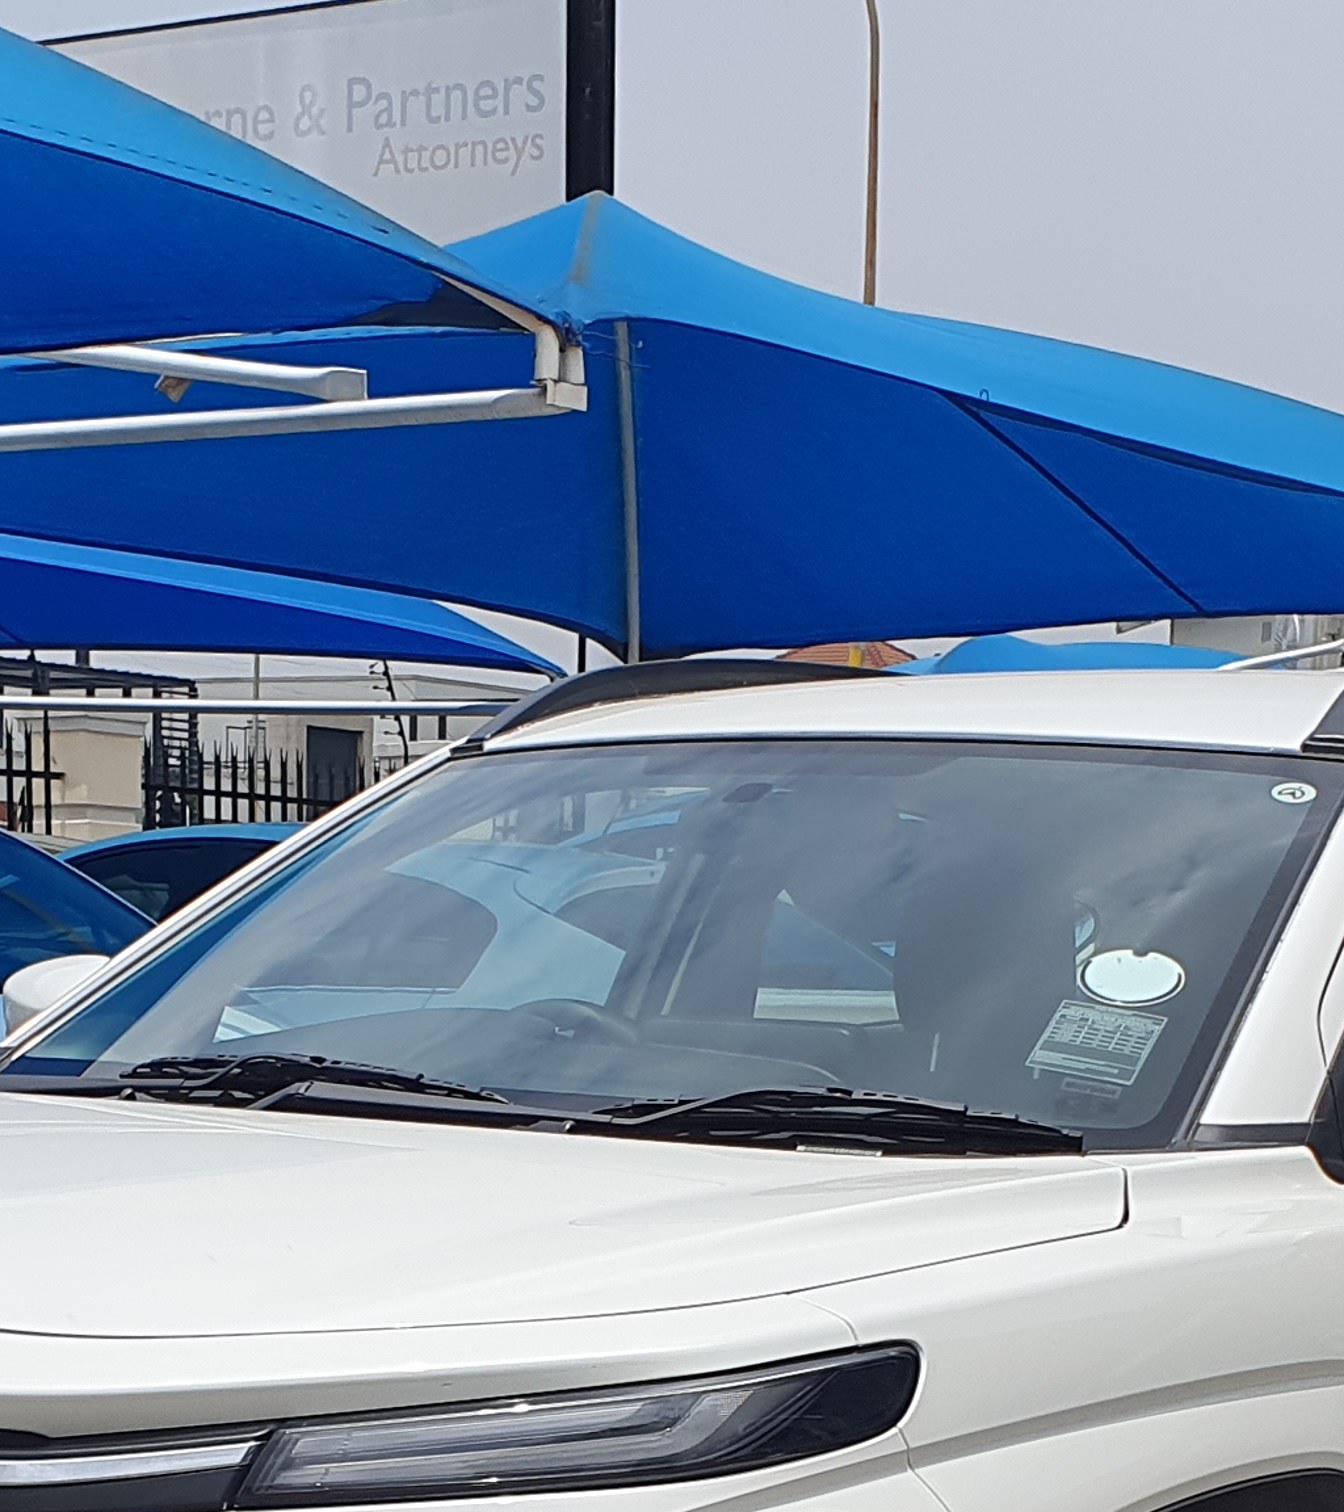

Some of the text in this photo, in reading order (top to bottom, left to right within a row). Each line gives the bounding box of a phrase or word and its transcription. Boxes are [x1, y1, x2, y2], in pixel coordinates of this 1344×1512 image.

[293, 84, 326, 138] &
[346, 74, 545, 133] Partners
[372, 131, 544, 177] Attorneys
